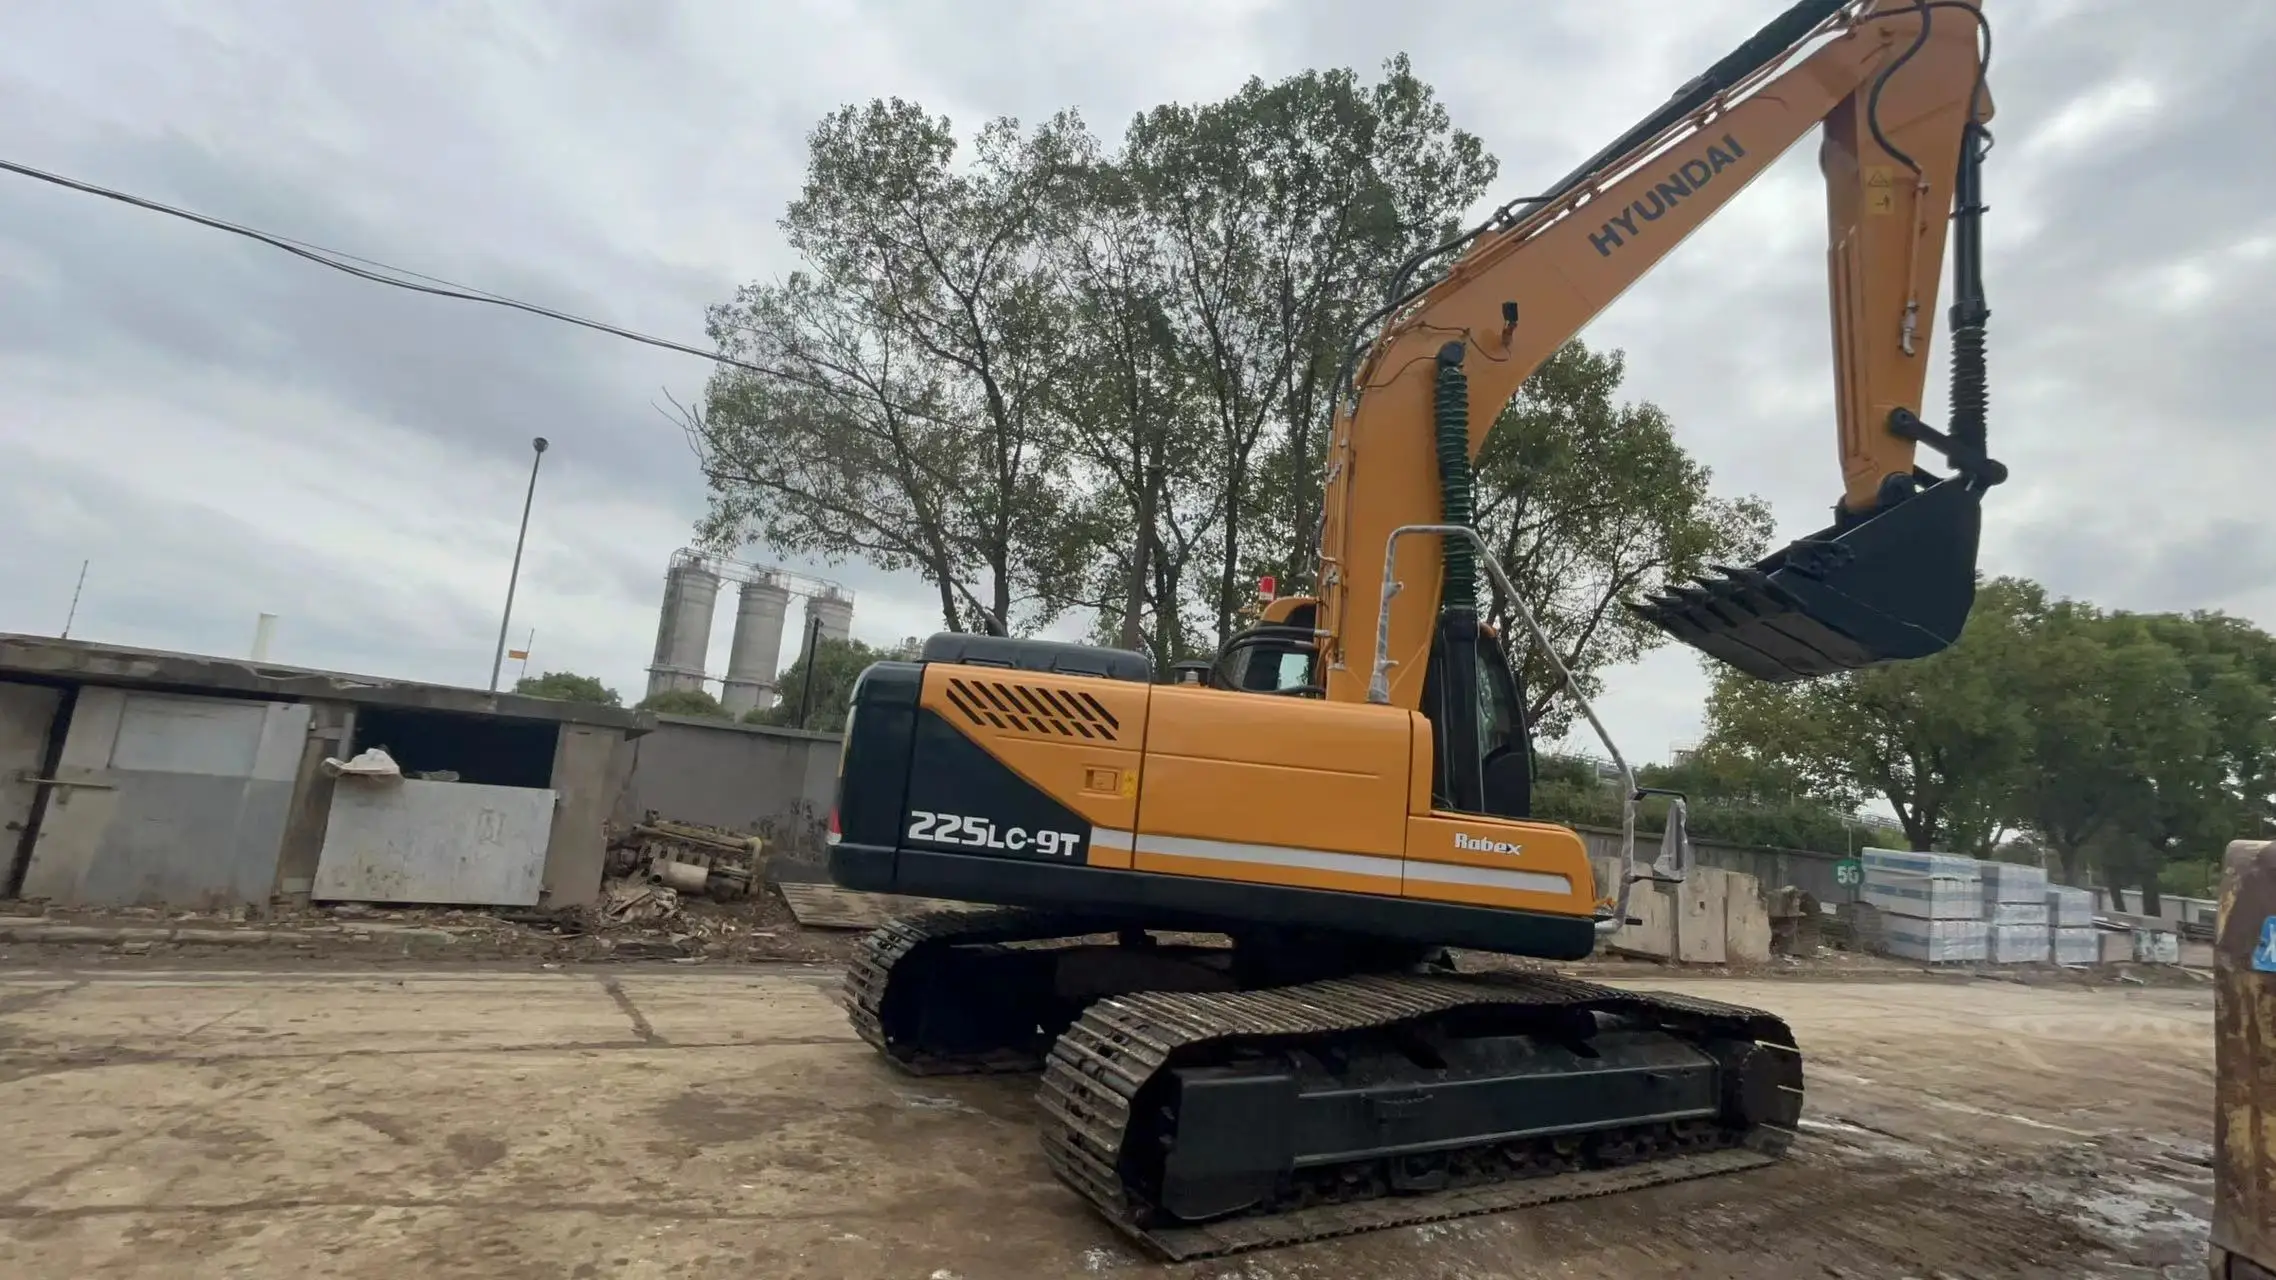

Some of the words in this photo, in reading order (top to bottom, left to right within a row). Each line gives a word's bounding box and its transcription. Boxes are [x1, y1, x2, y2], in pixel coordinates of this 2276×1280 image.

[1587, 132, 1746, 257] HYUNDAI
[908, 810, 1081, 856] 225LC-9T
[1454, 832, 1522, 856] Robex
